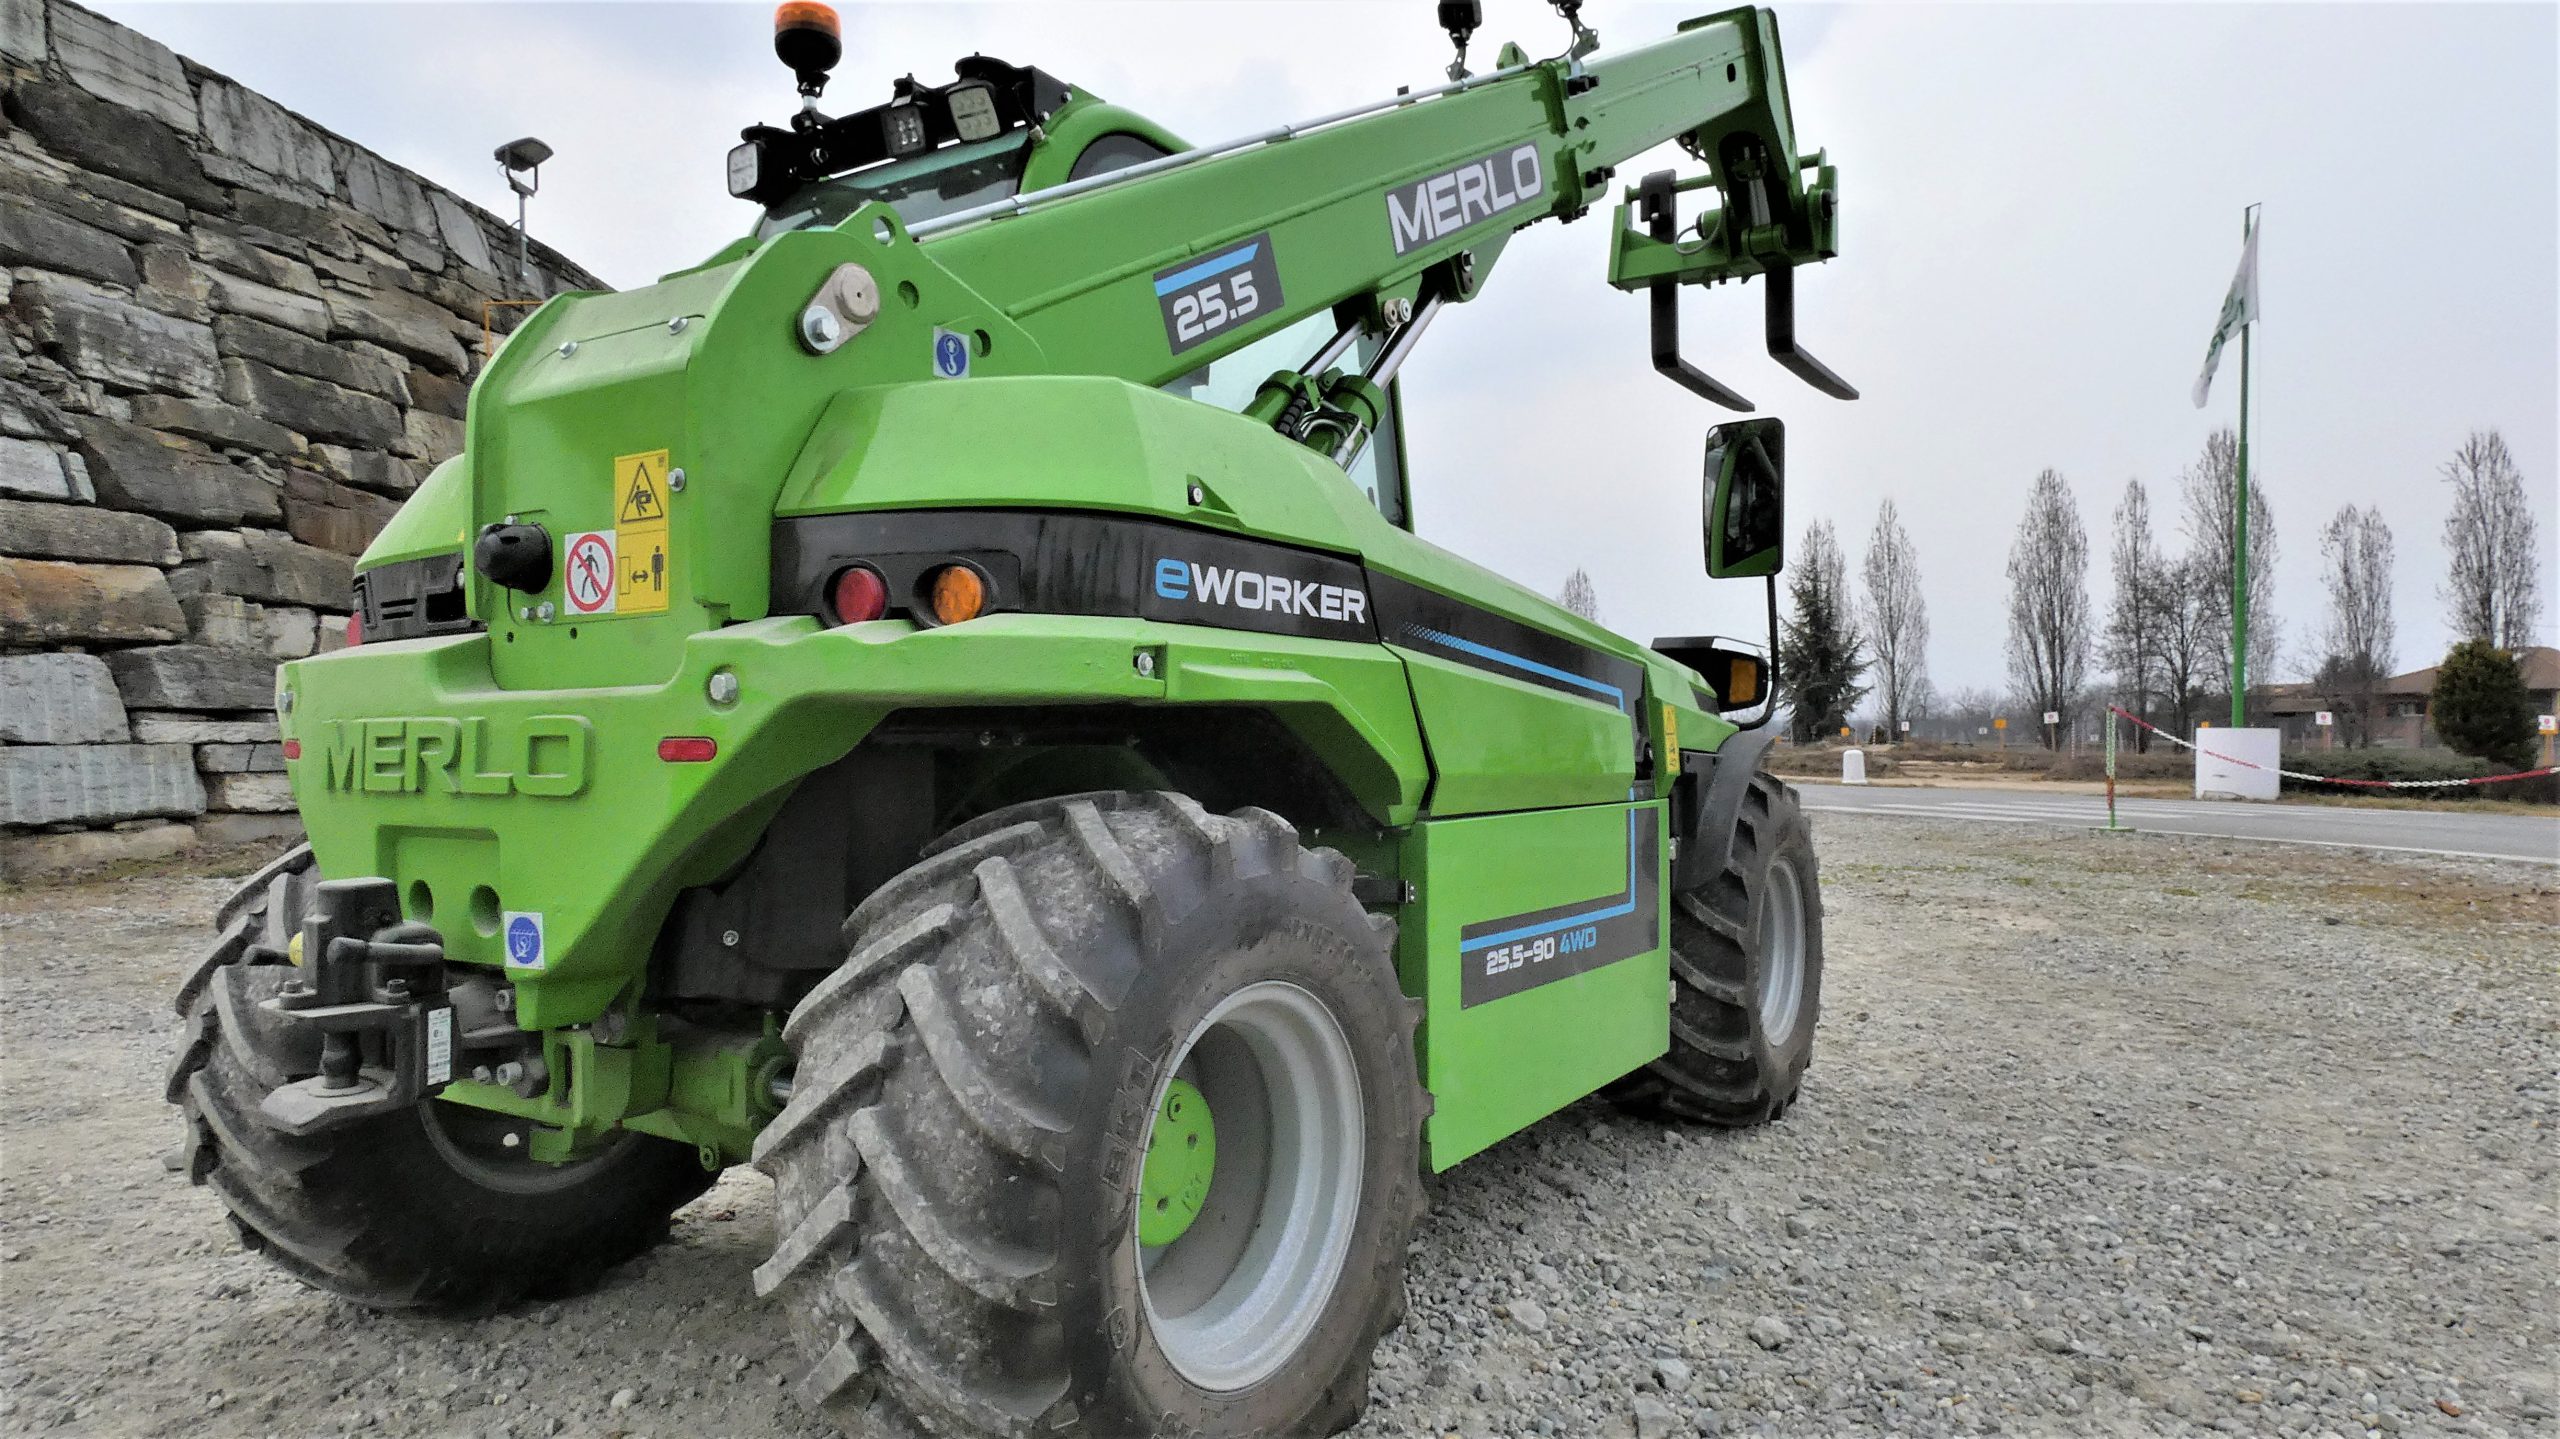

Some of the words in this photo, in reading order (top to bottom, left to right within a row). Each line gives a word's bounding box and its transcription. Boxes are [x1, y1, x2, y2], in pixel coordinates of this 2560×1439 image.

[1387, 143, 1543, 254] MERLO
[1173, 270, 1260, 342] 25.5
[1154, 558, 1366, 624] eWORKER
[322, 714, 592, 798] MERLO
[1486, 936, 1555, 976] 25.5-90
[1559, 926, 1597, 954] 4WD
